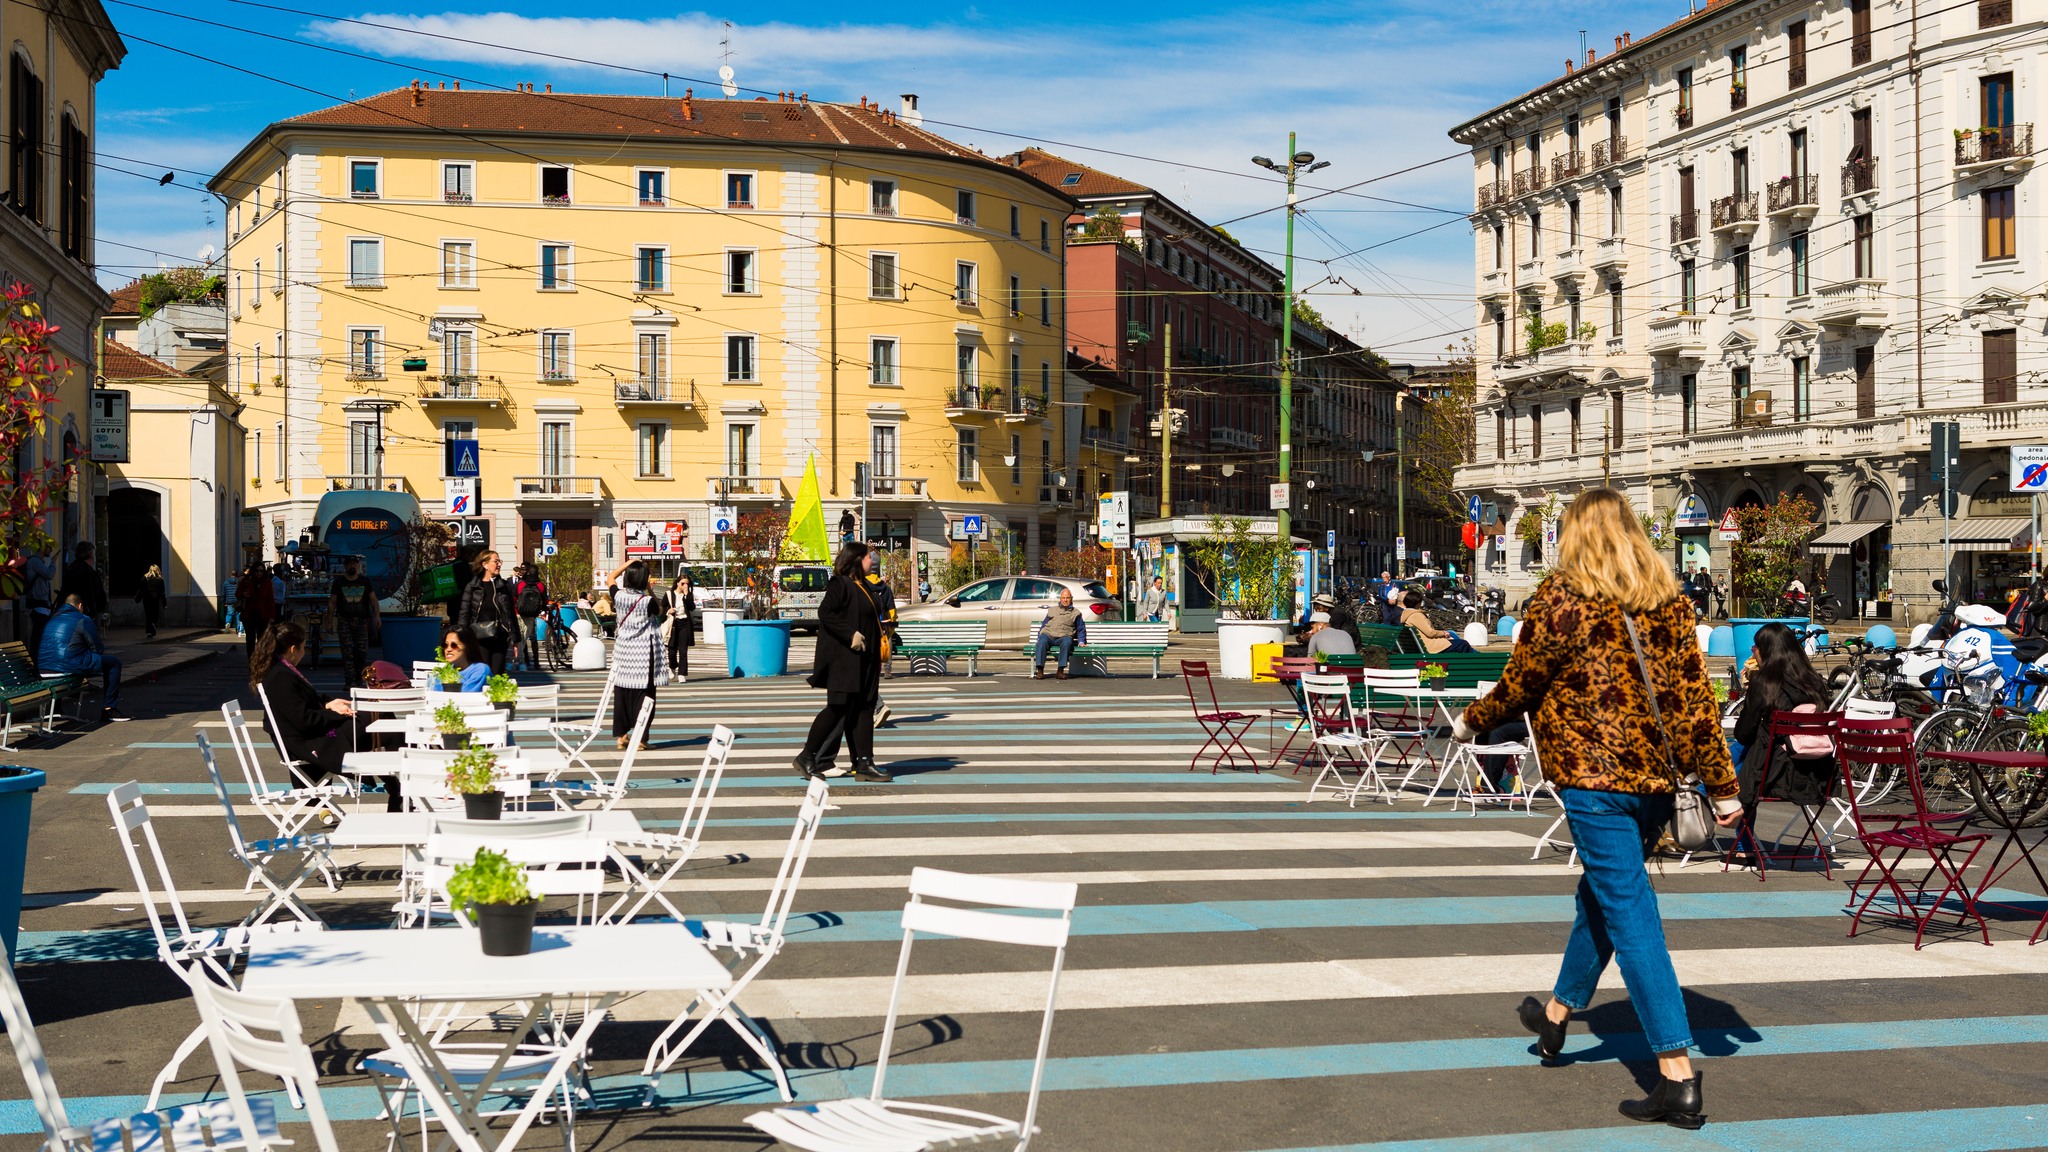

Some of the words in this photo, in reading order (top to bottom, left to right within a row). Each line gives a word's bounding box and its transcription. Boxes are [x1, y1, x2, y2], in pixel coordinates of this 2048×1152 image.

[95, 393, 122, 417] T
[336, 520, 342, 529] 9
[350, 520, 378, 529] CENTRALE
[380, 520, 389, 529] FS
[867, 539, 887, 547] Smile
[437, 577, 455, 585] Eats
[1964, 636, 1981, 647] 412
